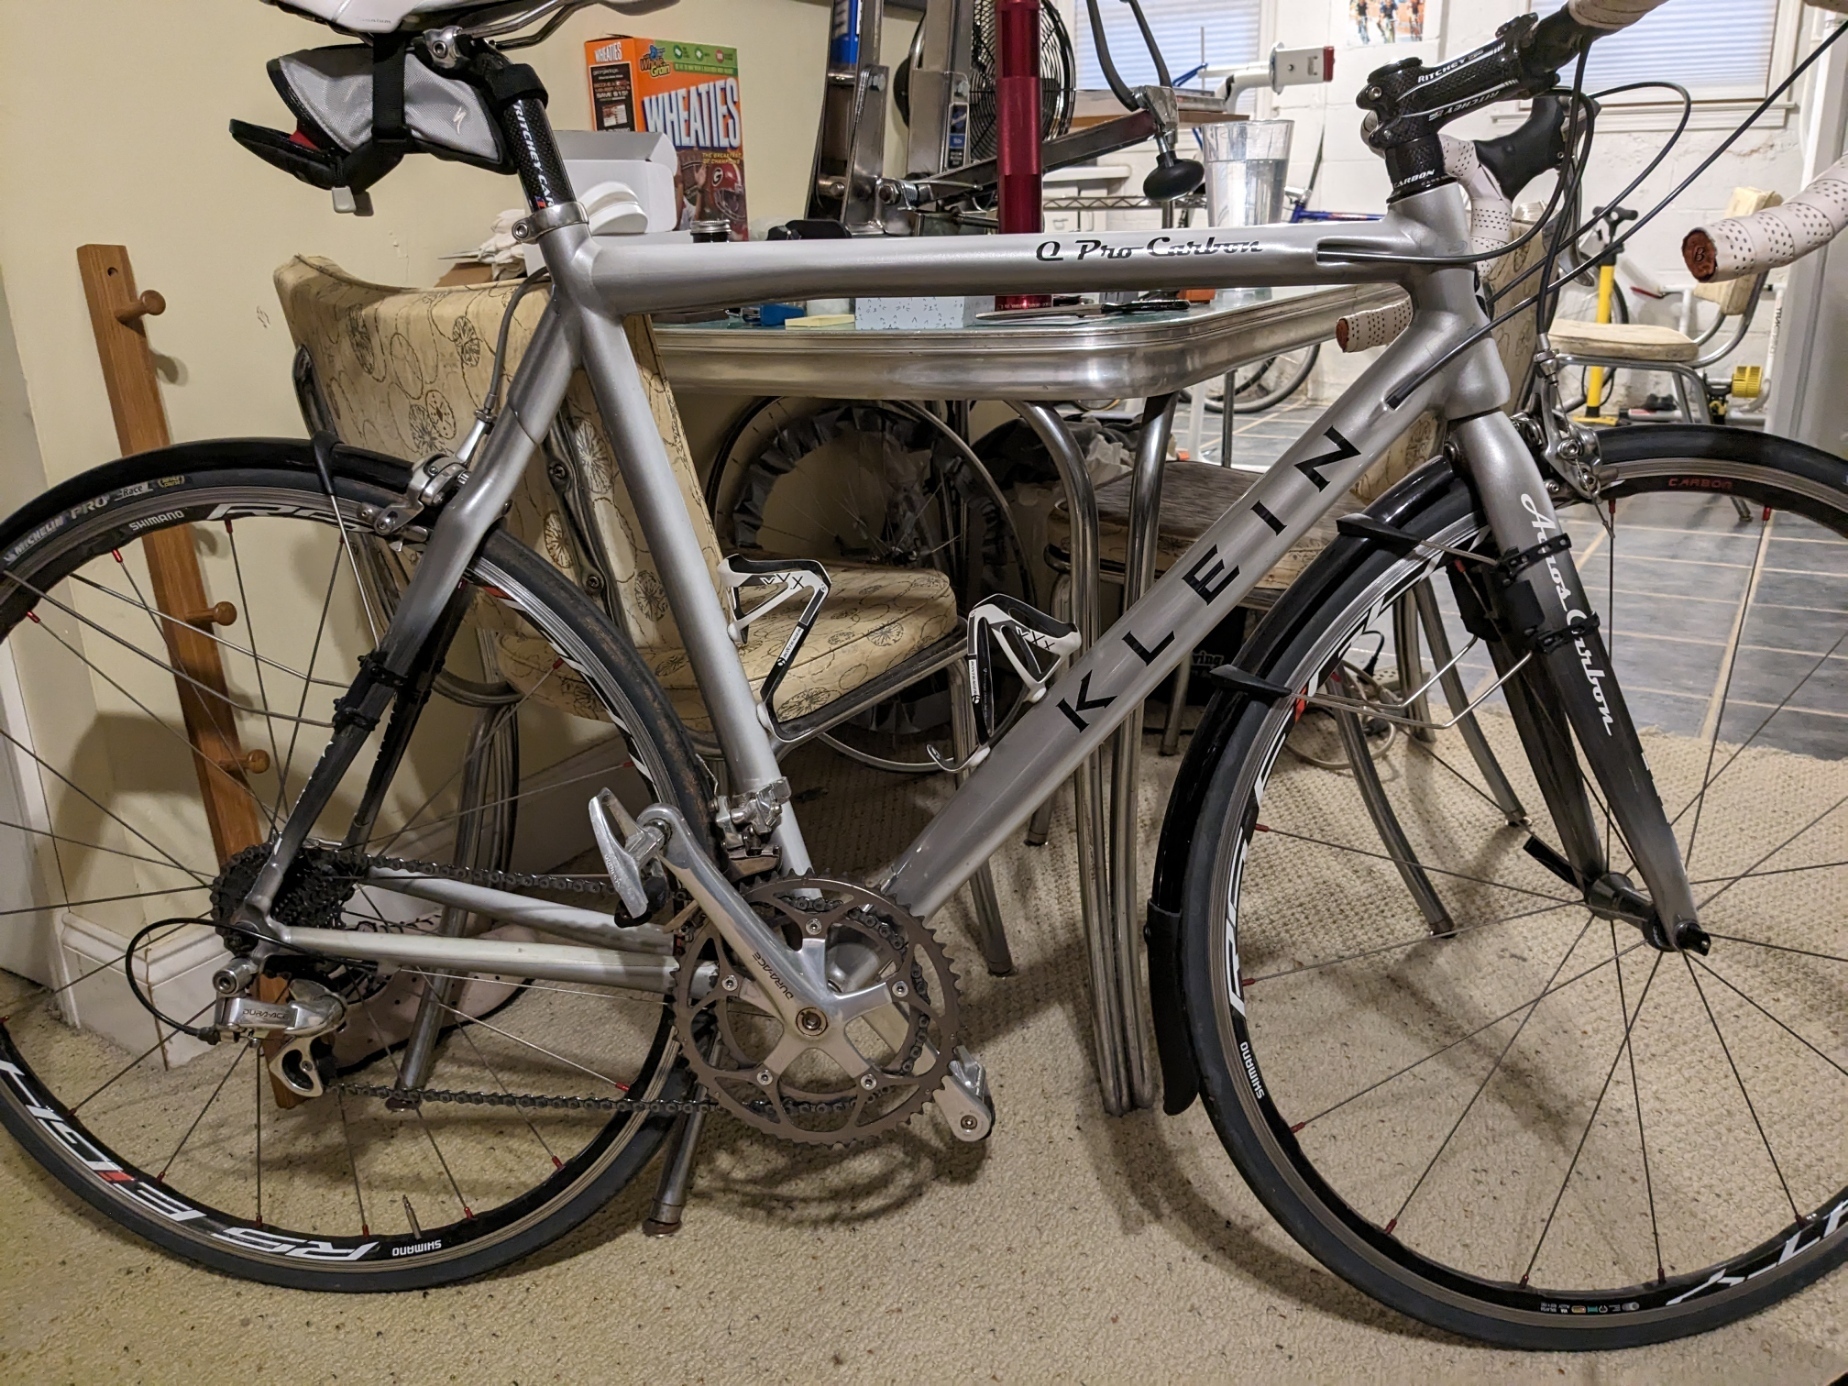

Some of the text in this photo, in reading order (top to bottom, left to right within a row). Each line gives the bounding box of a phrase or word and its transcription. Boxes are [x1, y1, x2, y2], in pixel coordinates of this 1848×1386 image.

[651, 65, 670, 77] Grain
[1417, 57, 1466, 84] RITCHEY
[643, 77, 742, 148] WHEATIES
[513, 104, 544, 172] RITCHEY
[1393, 168, 1435, 188] CARBON
[1036, 236, 1264, 262] Q Pro Carbon
[1668, 477, 1734, 490] CARBON
[129, 510, 186, 532] SHIMANO
[14, 515, 65, 556] MICHELIN
[1055, 425, 1362, 734] KLEIN
[751, 951, 794, 1000] DURA-ACE
[1239, 1041, 1265, 1100] SHIMANO
[391, 1239, 442, 1258] SHIMANO
